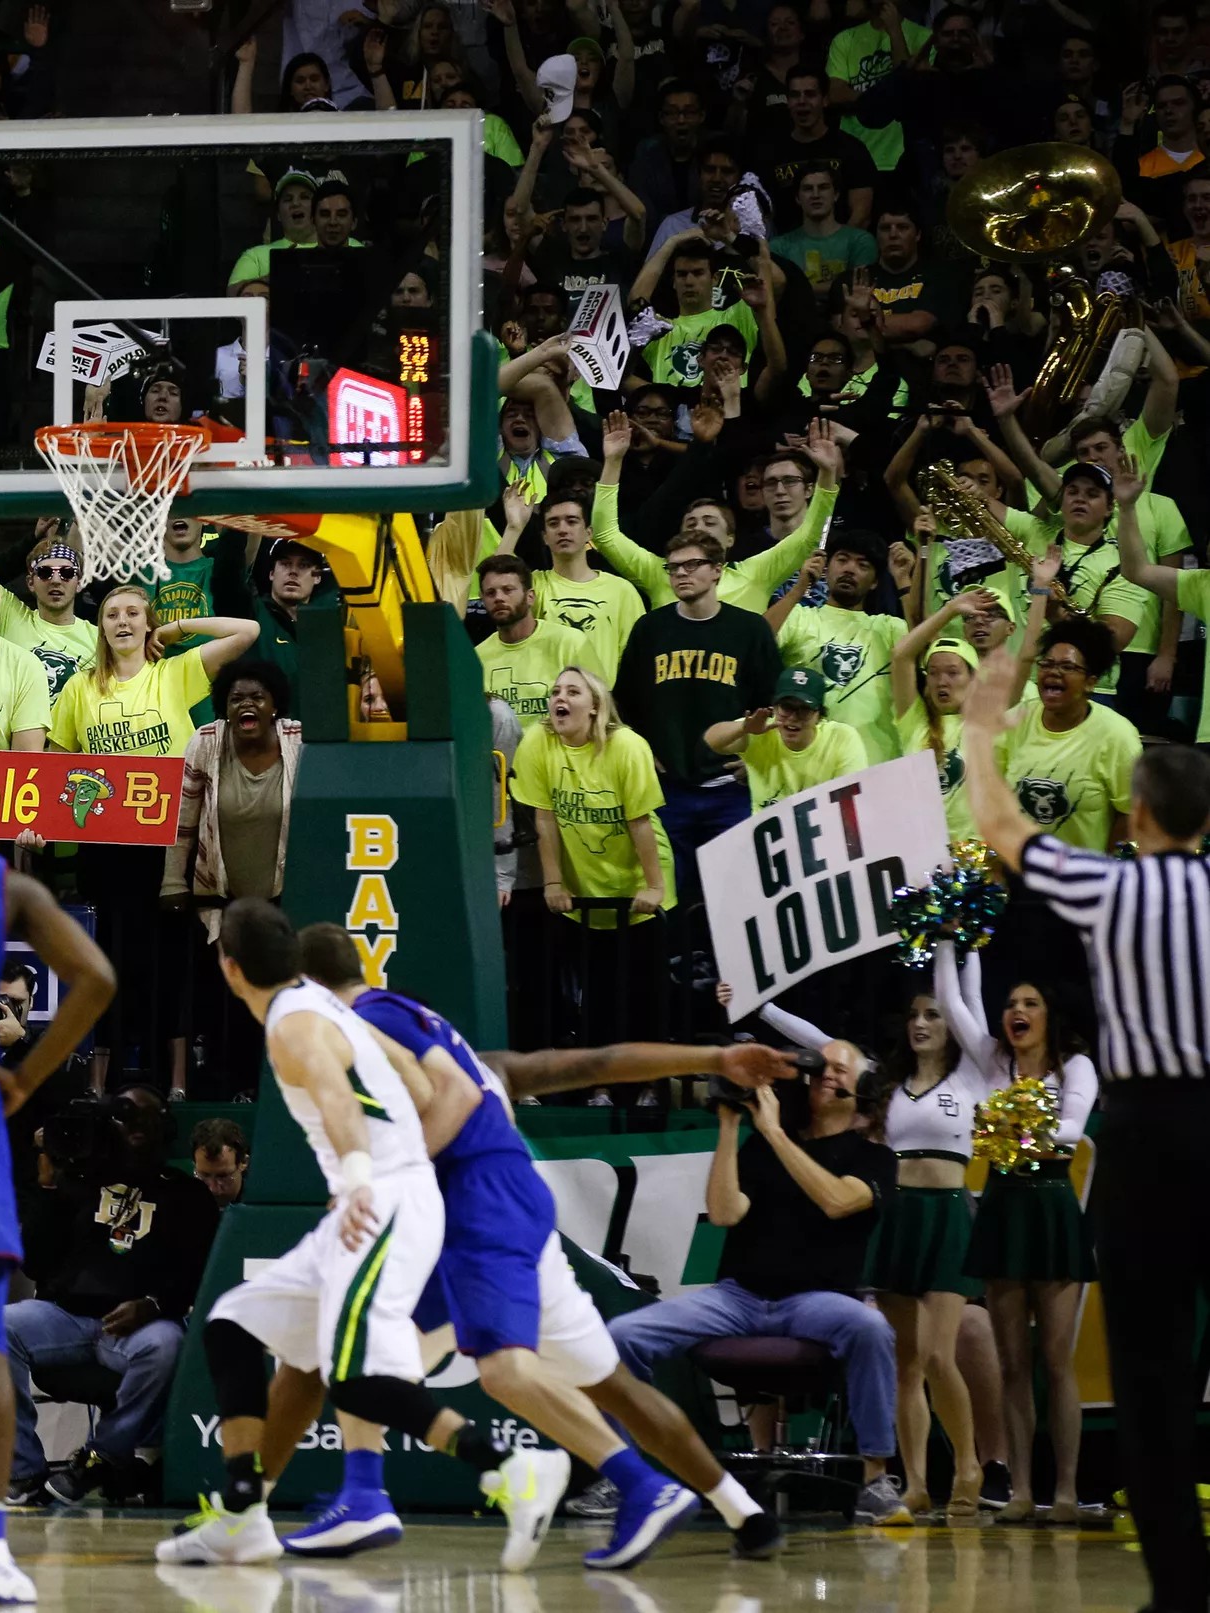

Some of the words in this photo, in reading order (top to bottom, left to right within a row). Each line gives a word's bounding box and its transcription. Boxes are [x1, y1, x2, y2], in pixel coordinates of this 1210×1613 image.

[107, 348, 146, 375] BAYLO
[570, 344, 605, 385] BAYLOR
[655, 649, 738, 687] BAYLOR
[87, 721, 132, 742] BAYLOR
[89, 722, 170, 755] BASKETBALL
[122, 771, 172, 825] BU
[753, 781, 864, 899] GET
